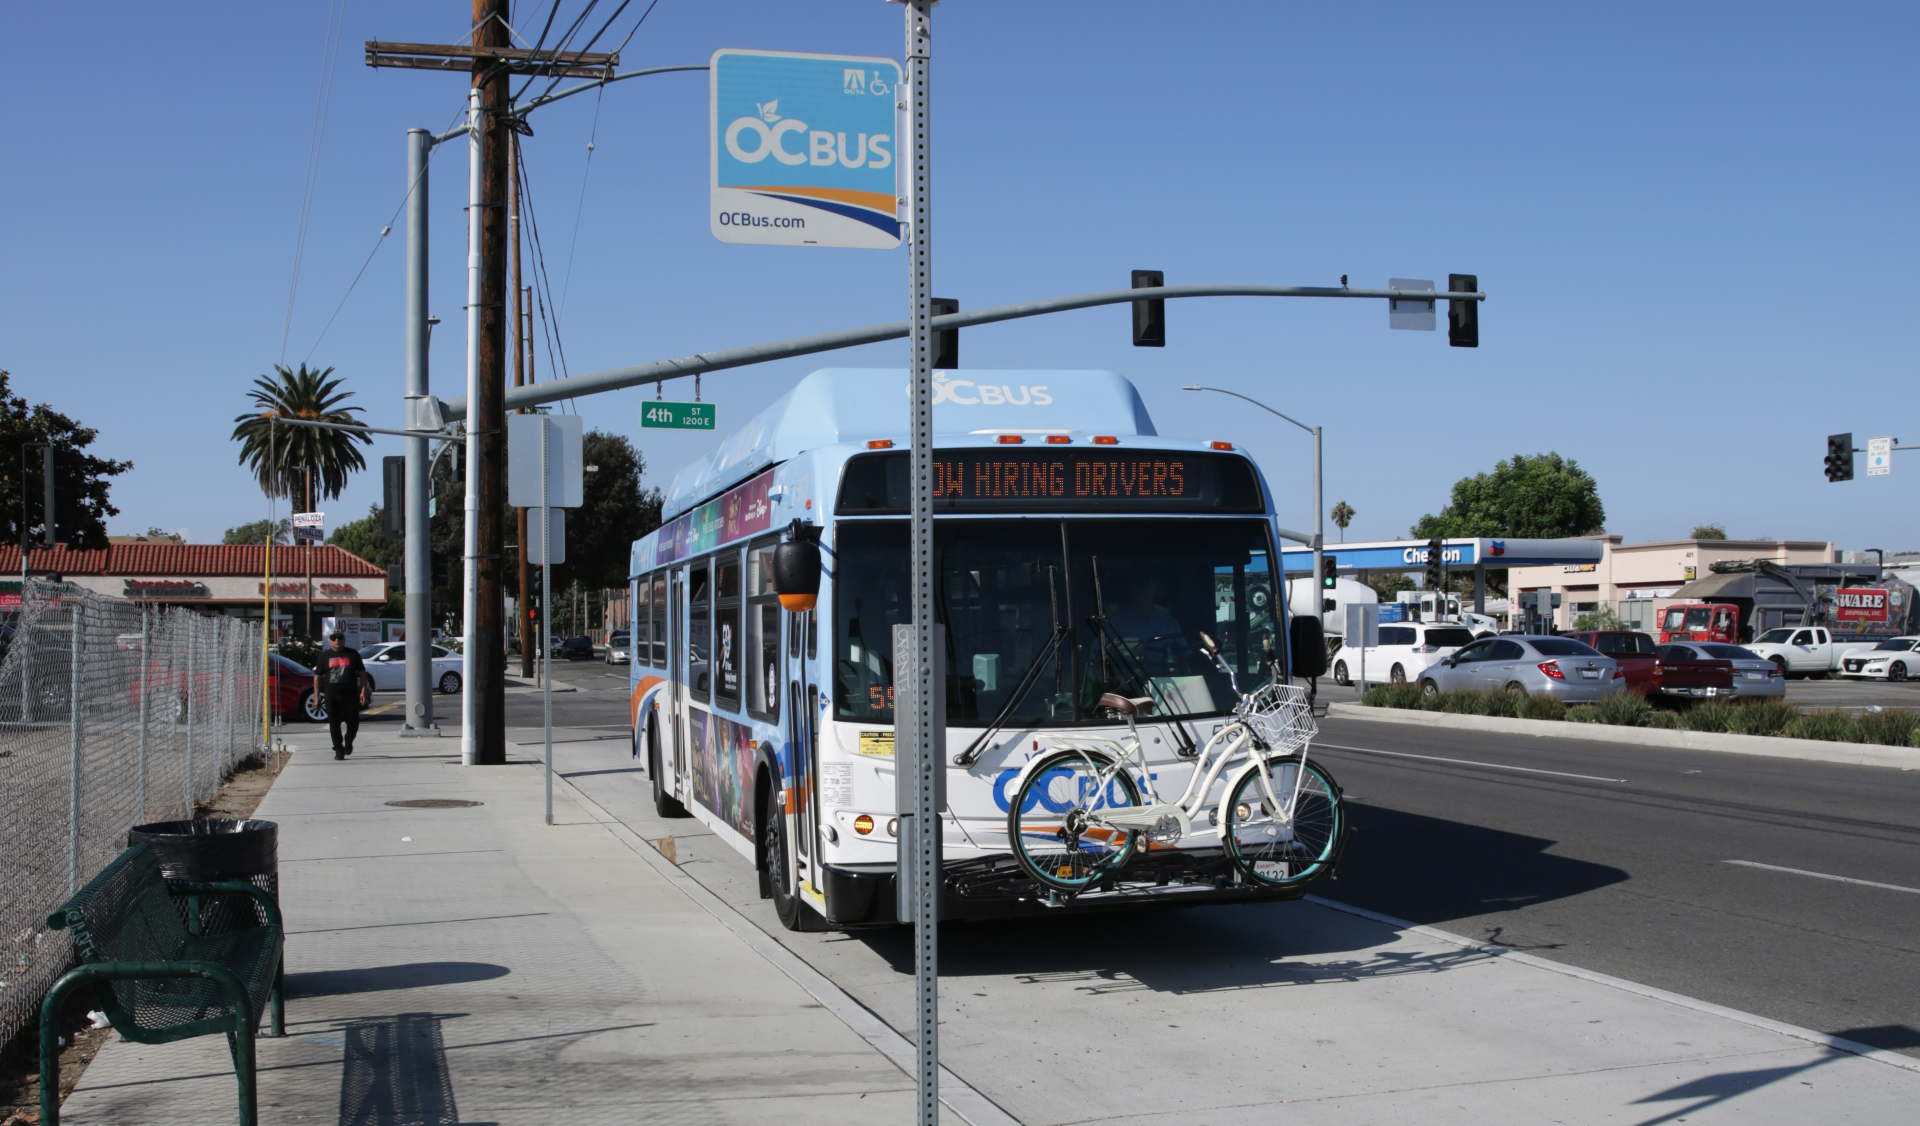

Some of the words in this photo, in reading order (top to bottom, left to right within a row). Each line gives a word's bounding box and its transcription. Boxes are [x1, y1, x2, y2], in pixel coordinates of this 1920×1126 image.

[719, 211, 805, 228] OCBus.com
[646, 407, 673, 422] 4th
[691, 407, 701, 415] ST
[683, 417, 703, 425] 1200
[932, 462, 963, 496] OW
[975, 462, 1064, 496] HIRING
[1076, 462, 1184, 496] DRIVERS
[1403, 547, 1461, 564] Cheon
[319, 582, 351, 594] STAR
[1839, 594, 1885, 608] WARE
